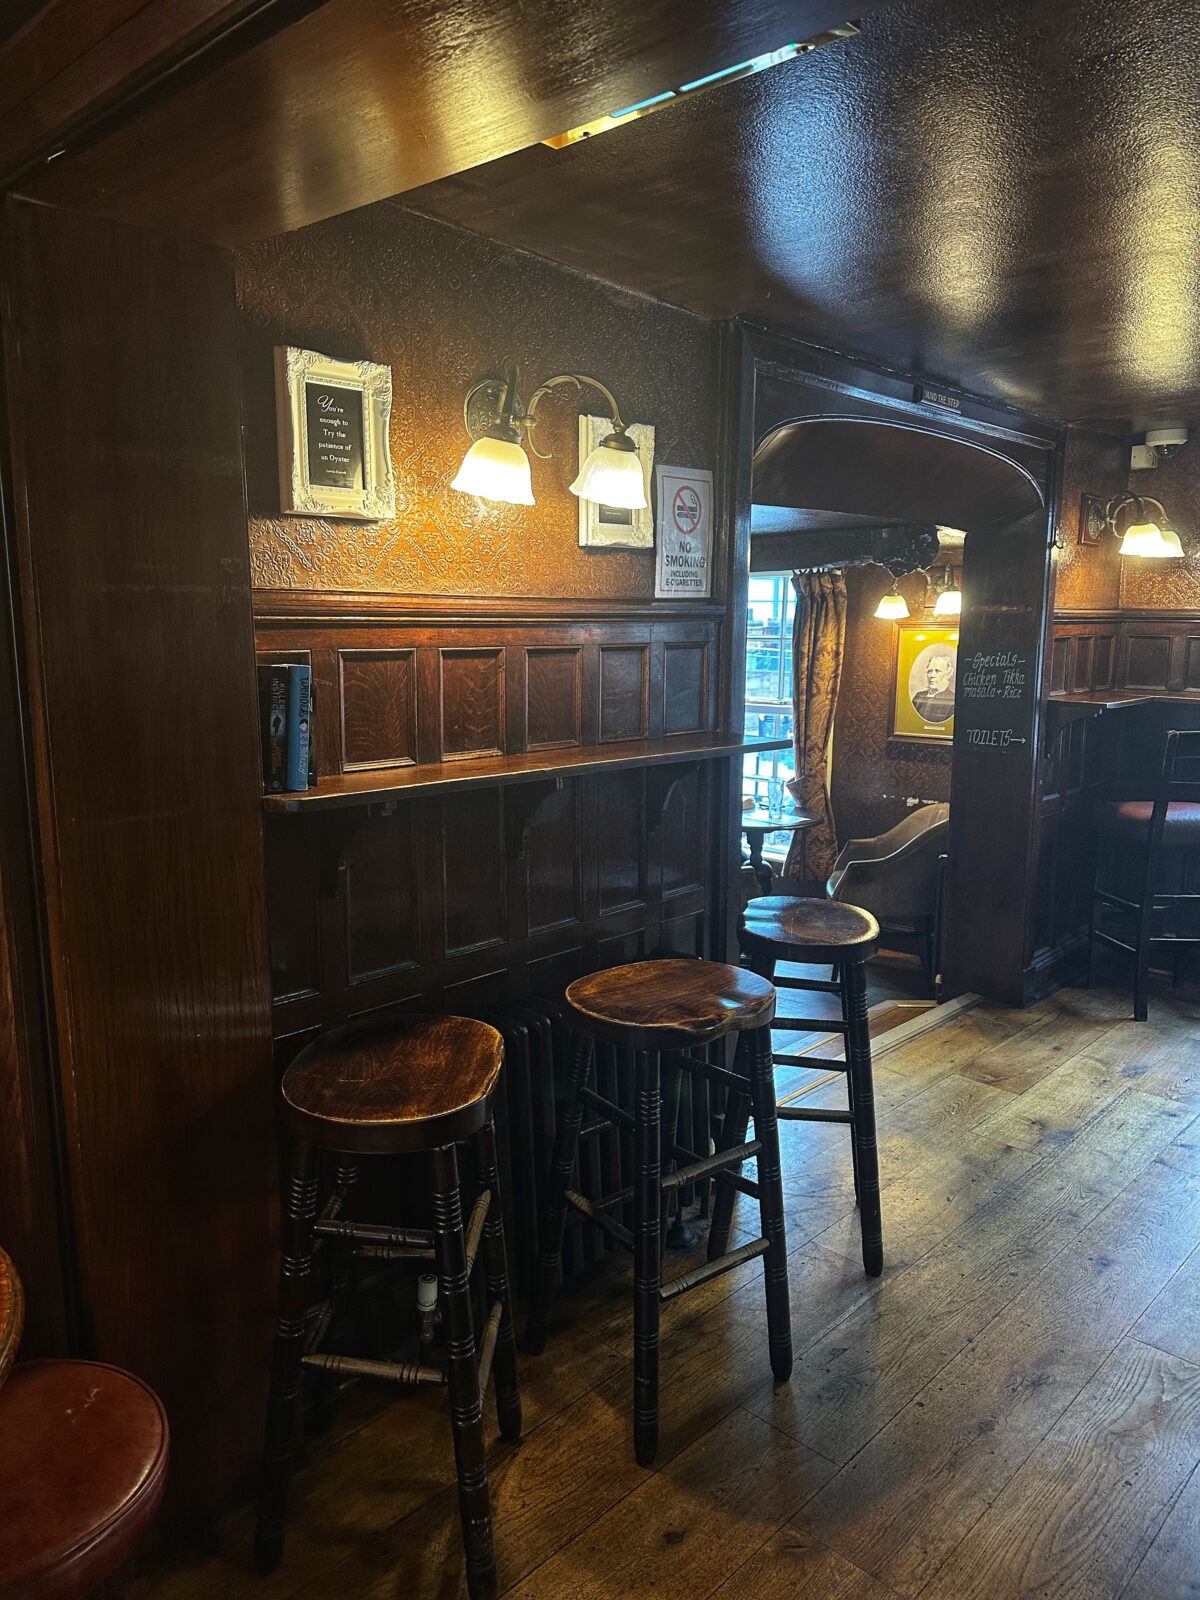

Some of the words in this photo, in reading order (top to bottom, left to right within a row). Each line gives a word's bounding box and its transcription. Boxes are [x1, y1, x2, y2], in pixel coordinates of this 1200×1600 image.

[317, 394, 344, 413] You're
[937, 394, 947, 404] THE
[947, 397, 960, 408] STEP
[320, 417, 341, 427] enough
[323, 428, 335, 438] Try
[336, 430, 346, 438] the
[318, 442, 344, 450] patience
[329, 454, 350, 463] Oyster
[679, 541, 692, 553] NO
[665, 555, 706, 568] SMOKING
[670, 570, 699, 578] INCLUDING
[963, 669, 997, 687] Chicken
[1003, 669, 1025, 685] Tikka
[1002, 685, 1022, 699] Rice
[966, 728, 1013, 746] TOILETS
